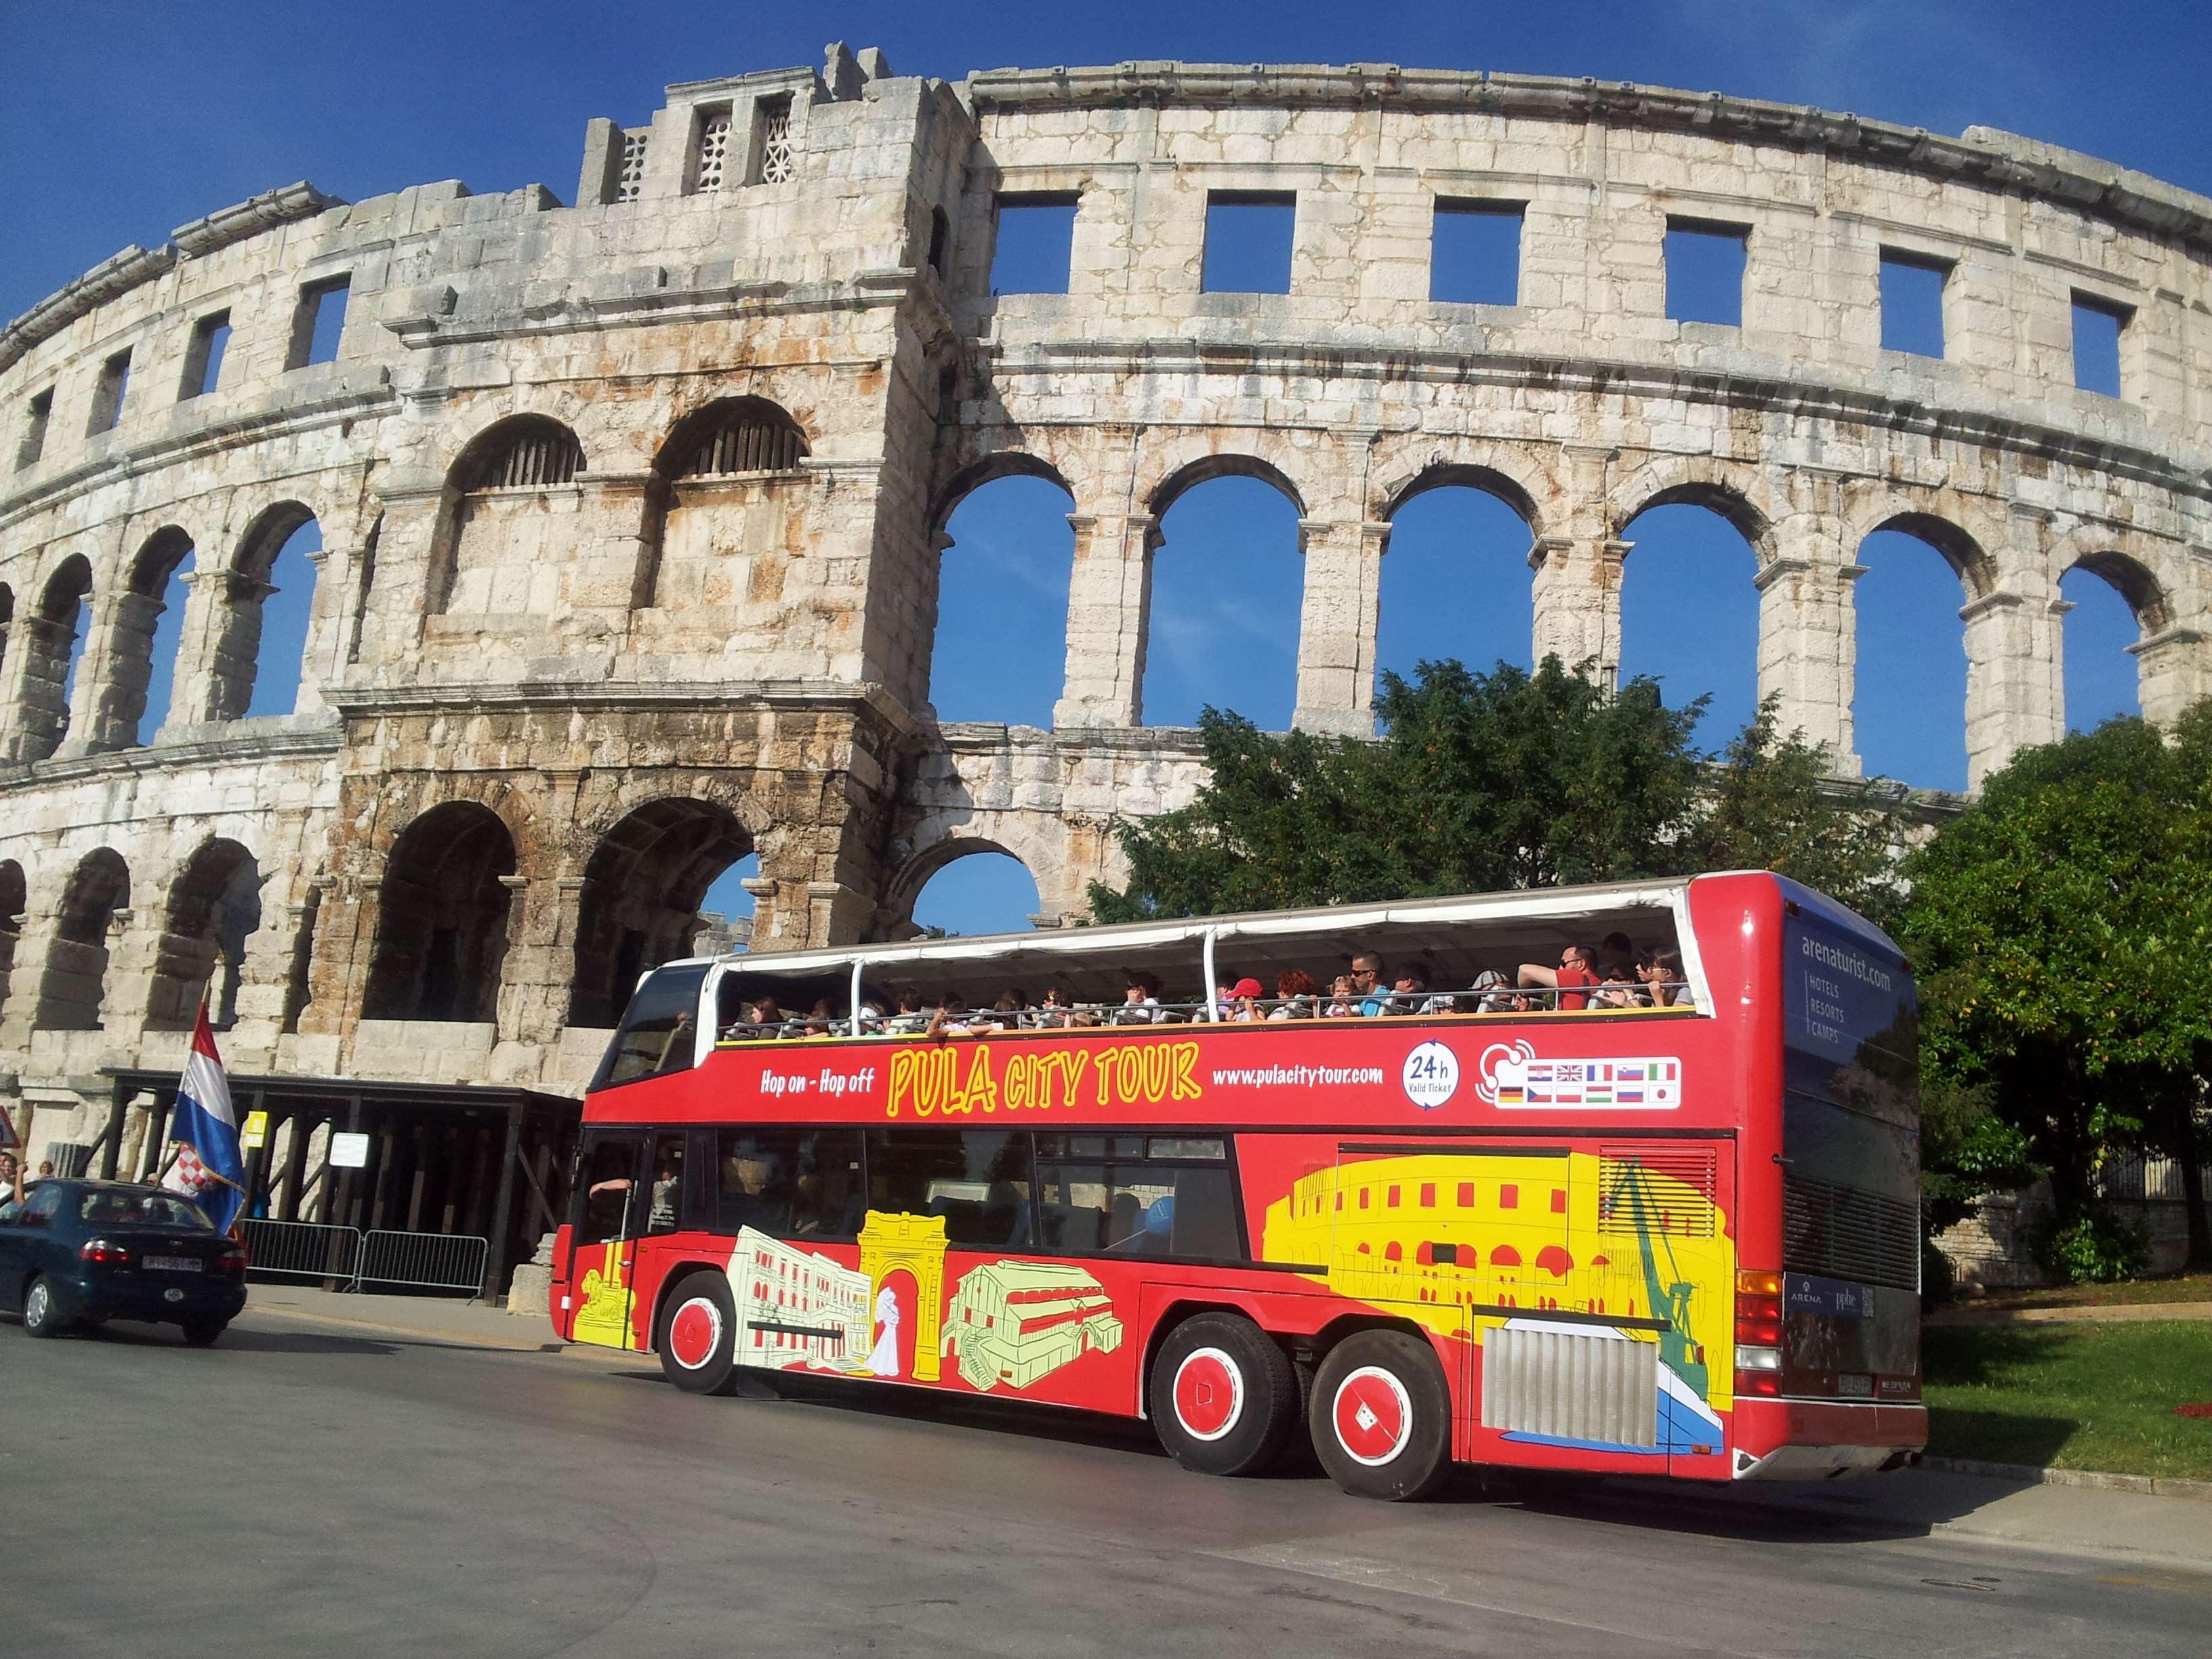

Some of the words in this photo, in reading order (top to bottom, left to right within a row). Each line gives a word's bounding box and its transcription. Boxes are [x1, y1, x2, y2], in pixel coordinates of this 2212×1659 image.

[1802, 936, 1891, 992] arenaturist.com
[1809, 975, 1839, 999] HOTELS
[1811, 998, 1844, 1023] RESORTS
[1811, 1022, 1839, 1043] CAMPS
[760, 1069, 786, 1098] Hop
[788, 1076, 806, 1093] on
[819, 1067, 846, 1098] Hop
[848, 1067, 876, 1092] off
[886, 1044, 998, 1118] PULA
[1004, 1049, 1089, 1110] CITY
[1094, 1041, 1202, 1105] TOUR
[1212, 1063, 1383, 1088] www.pulacitytour.com
[1409, 1082, 1426, 1092] Valid
[1428, 1082, 1452, 1092] Ticket
[1791, 1293, 1822, 1304] ARENA
